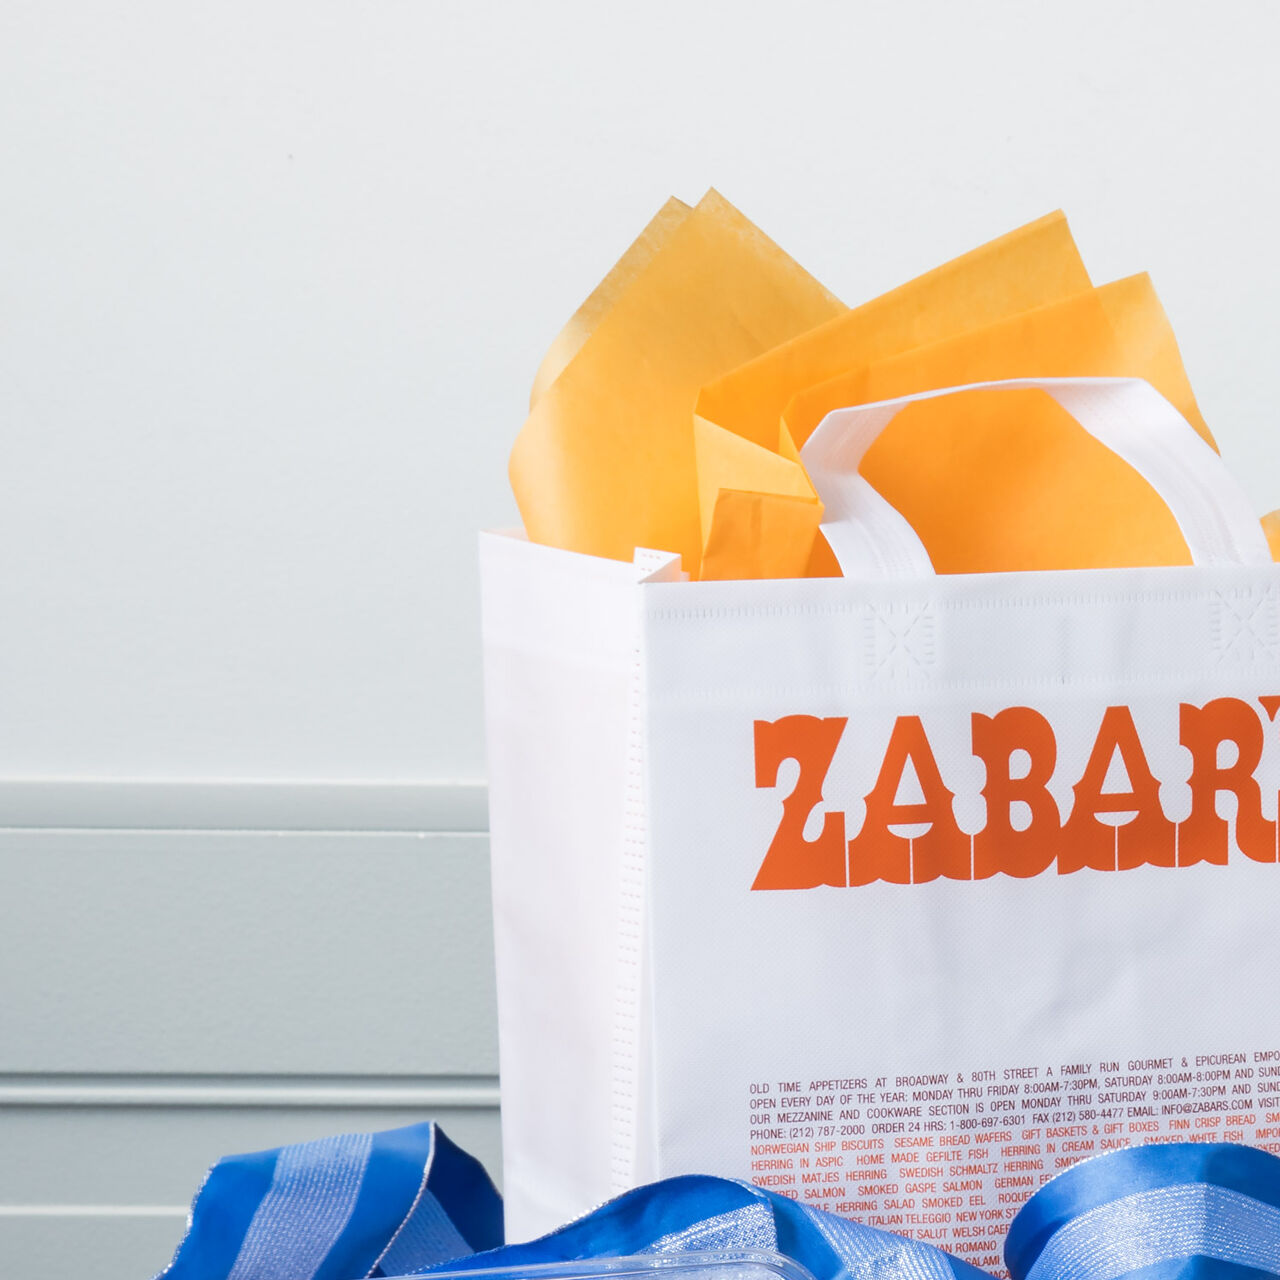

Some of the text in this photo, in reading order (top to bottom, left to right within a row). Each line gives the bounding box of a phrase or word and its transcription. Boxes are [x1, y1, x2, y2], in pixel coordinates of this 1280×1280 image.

[749, 1083, 770, 1096] OLD
[777, 1081, 802, 1094] TIME
[808, 1077, 868, 1093] APPETIZERS
[873, 1076, 888, 1089] AT
[895, 1072, 949, 1087] BROADWAY
[955, 1072, 964, 1084] &
[971, 1069, 996, 1083] 80TH
[1003, 1067, 1038, 1081] STREET
[1045, 1066, 1054, 1078] A
[1059, 1063, 1092, 1077] FAMILY
[1099, 1061, 1120, 1074] RUN
[1127, 1058, 1172, 1072] GOURMET
[1180, 1057, 1188, 1069] &
[1195, 1052, 1246, 1068] EPICUREAN
[749, 1098, 776, 1111] OPEN
[780, 1096, 812, 1109] EVERY
[815, 1094, 836, 1107] DAY
[839, 1093, 853, 1106] OF
[855, 1092, 876, 1105] THE
[879, 1090, 908, 1103] YEAR:
[911, 1087, 954, 1101] MONDAY
[957, 1085, 983, 1098] THRU
[986, 1083, 1020, 1097] FRIDAY
[1023, 1078, 1100, 1096] 8:00AM-7:30PM,
[1103, 1074, 1153, 1089] SATURDAY
[1157, 1069, 1231, 1085] 8:00AM-8:00PM
[1233, 1067, 1254, 1080] AND
[749, 1114, 771, 1126] OUR
[776, 1110, 833, 1125] MEZZANINE
[838, 1108, 860, 1121] AND
[865, 1105, 922, 1120] COOKWARE
[927, 1102, 970, 1116] SECTION
[975, 1101, 984, 1113] IS
[989, 1099, 1016, 1112] OPEN
[1020, 1096, 1062, 1110] MONDAY
[1067, 1094, 1092, 1107] THRU
[1097, 1090, 1146, 1105] SATURDAY
[1151, 1084, 1226, 1101] 9:00AM-7:30PM
[1231, 1083, 1252, 1096] AND
[749, 1128, 786, 1142] PHONE:
[788, 1127, 814, 1141] (212)
[817, 1124, 866, 1138] 787-2000
[871, 1121, 905, 1135] ORDER
[907, 1120, 920, 1133] 24
[923, 1119, 946, 1132] HRS:
[949, 1114, 1026, 1130] 1-800-697-6301
[1031, 1112, 1050, 1125] FAX
[1051, 1110, 1076, 1125] (212)
[1077, 1107, 1124, 1122] 580-4477
[1126, 1105, 1158, 1118] EMAIL:
[1161, 1098, 1253, 1116] INFO@ZABARS.COM
[1257, 1096, 1280, 1109] VISIT
[749, 1142, 810, 1157] NORWEGIAN
[813, 1140, 836, 1154] SHIP
[840, 1137, 884, 1152] BISCUITS
[893, 1134, 934, 1149] SESAME
[938, 1132, 971, 1146] BREAD
[973, 1129, 1012, 1144] WAFERS
[1021, 1128, 1042, 1141] GIFT
[1045, 1124, 1088, 1139] BASKETS
[1103, 1122, 1124, 1135] GIFT
[1127, 1120, 1160, 1134] BOXES
[1167, 1117, 1190, 1131] FINN
[1193, 1115, 1222, 1129] CRISP
[1225, 1113, 1256, 1127] BREAD
